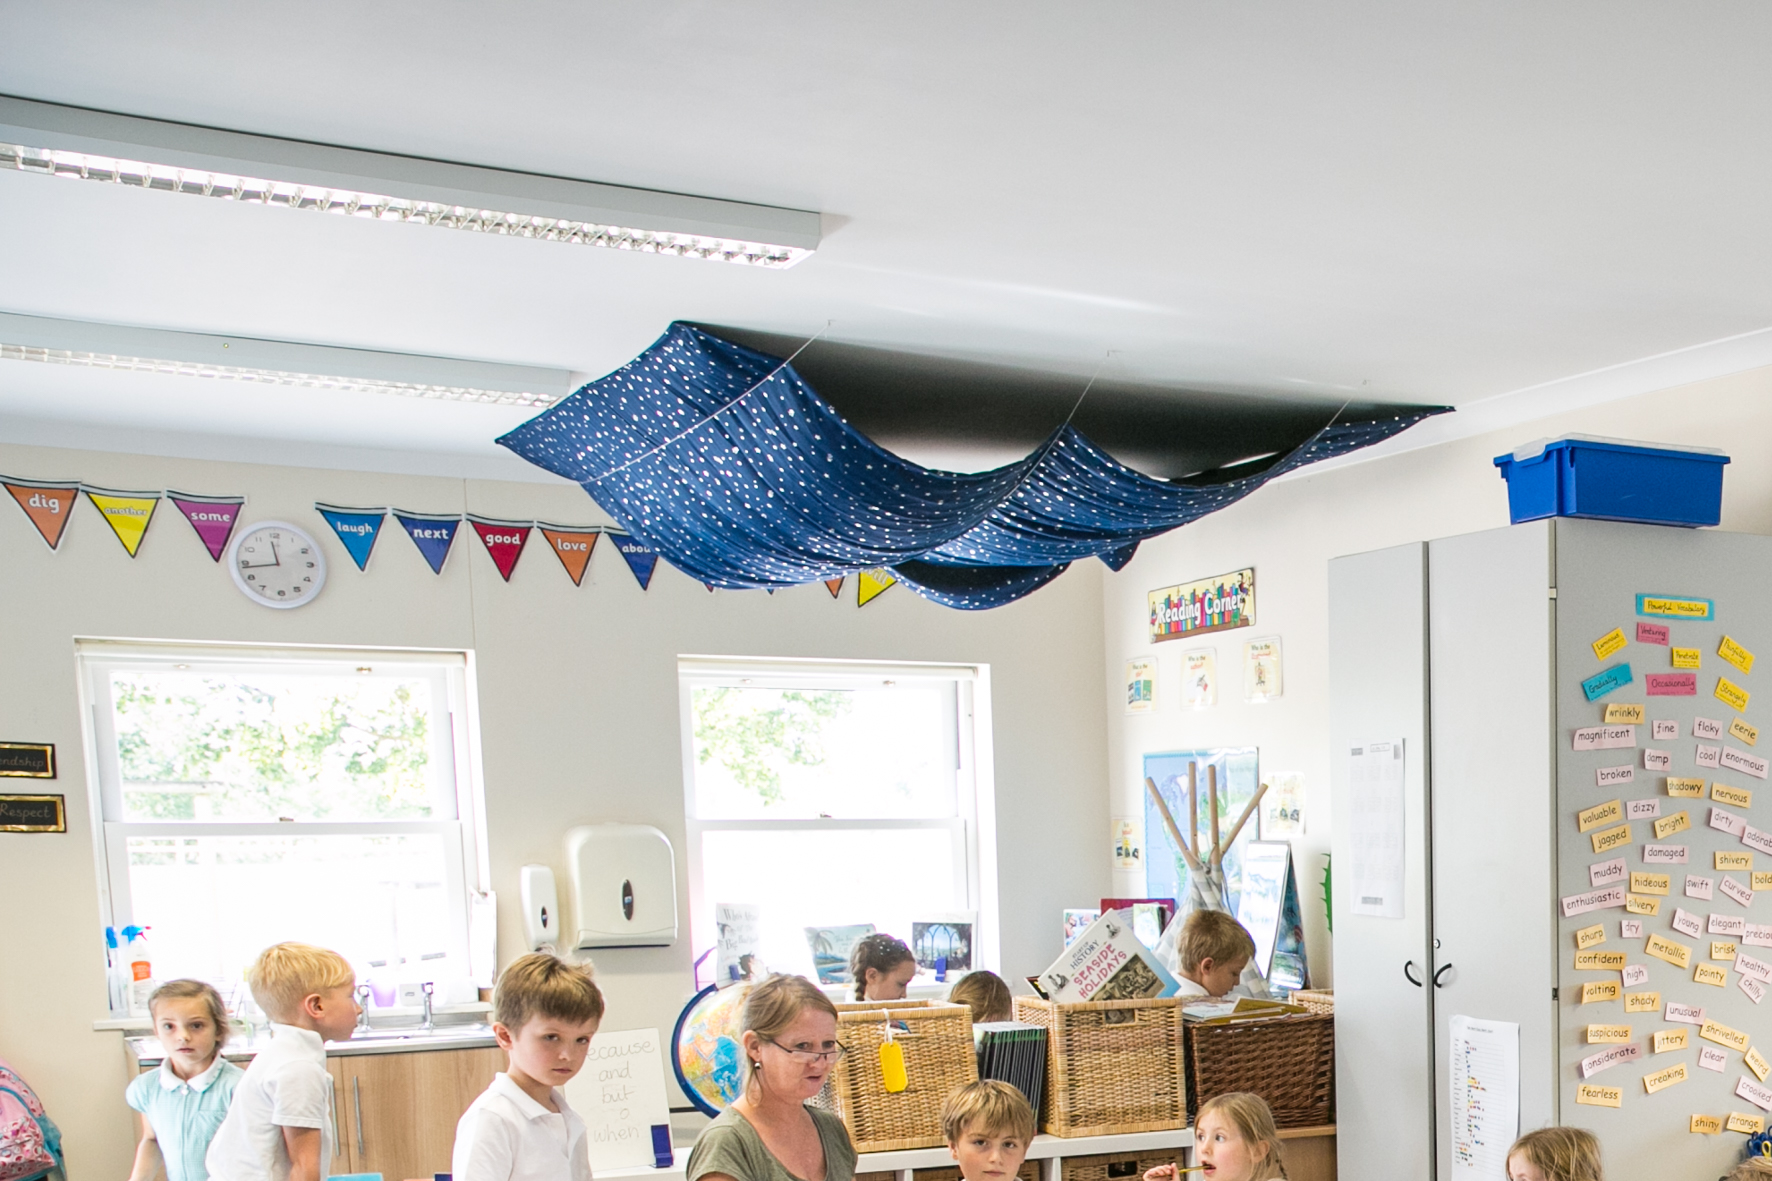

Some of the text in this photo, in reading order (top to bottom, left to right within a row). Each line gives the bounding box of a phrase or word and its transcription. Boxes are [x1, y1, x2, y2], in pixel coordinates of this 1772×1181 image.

[28, 493, 59, 513] dig
[104, 506, 147, 516] another
[191, 511, 230, 522] some
[336, 521, 373, 536] laugh
[413, 527, 448, 539] next
[486, 533, 521, 547] good
[556, 538, 587, 551] love
[1157, 590, 1243, 625] Reading Corner
[1578, 729, 1630, 743] magnificent
[1657, 723, 1675, 734] fine
[1734, 722, 1756, 740] eerie
[1647, 753, 1669, 766] damp
[1725, 752, 1765, 772] enormous
[1600, 768, 1632, 780] broken
[1715, 788, 1748, 803] nervous
[0, 803, 52, 823] Respect
[1582, 806, 1617, 824] valuable
[1659, 816, 1685, 832] bright
[1714, 814, 1734, 828] dirty
[1648, 848, 1685, 859] damaged
[1594, 865, 1623, 880] muddy
[1755, 874, 1772, 884] bold
[1634, 878, 1668, 888] hideous
[1723, 880, 1752, 901] curved
[1628, 899, 1655, 912] silvery
[1677, 915, 1700, 932] young
[1580, 929, 1604, 944] sharp
[1070, 940, 1100, 970] HISTORY
[1652, 941, 1686, 960] metallic
[1073, 943, 1116, 986] SEASIDE
[1578, 955, 1623, 965] confident
[1078, 950, 1127, 999] HOLIDAYS
[1626, 967, 1644, 981] high
[1699, 969, 1725, 981] pointy
[1589, 1028, 1628, 1039] suspicious
[587, 1041, 655, 1061] ecause
[599, 1060, 632, 1082] and
[602, 1084, 635, 1104] but
[594, 1123, 639, 1143] when
